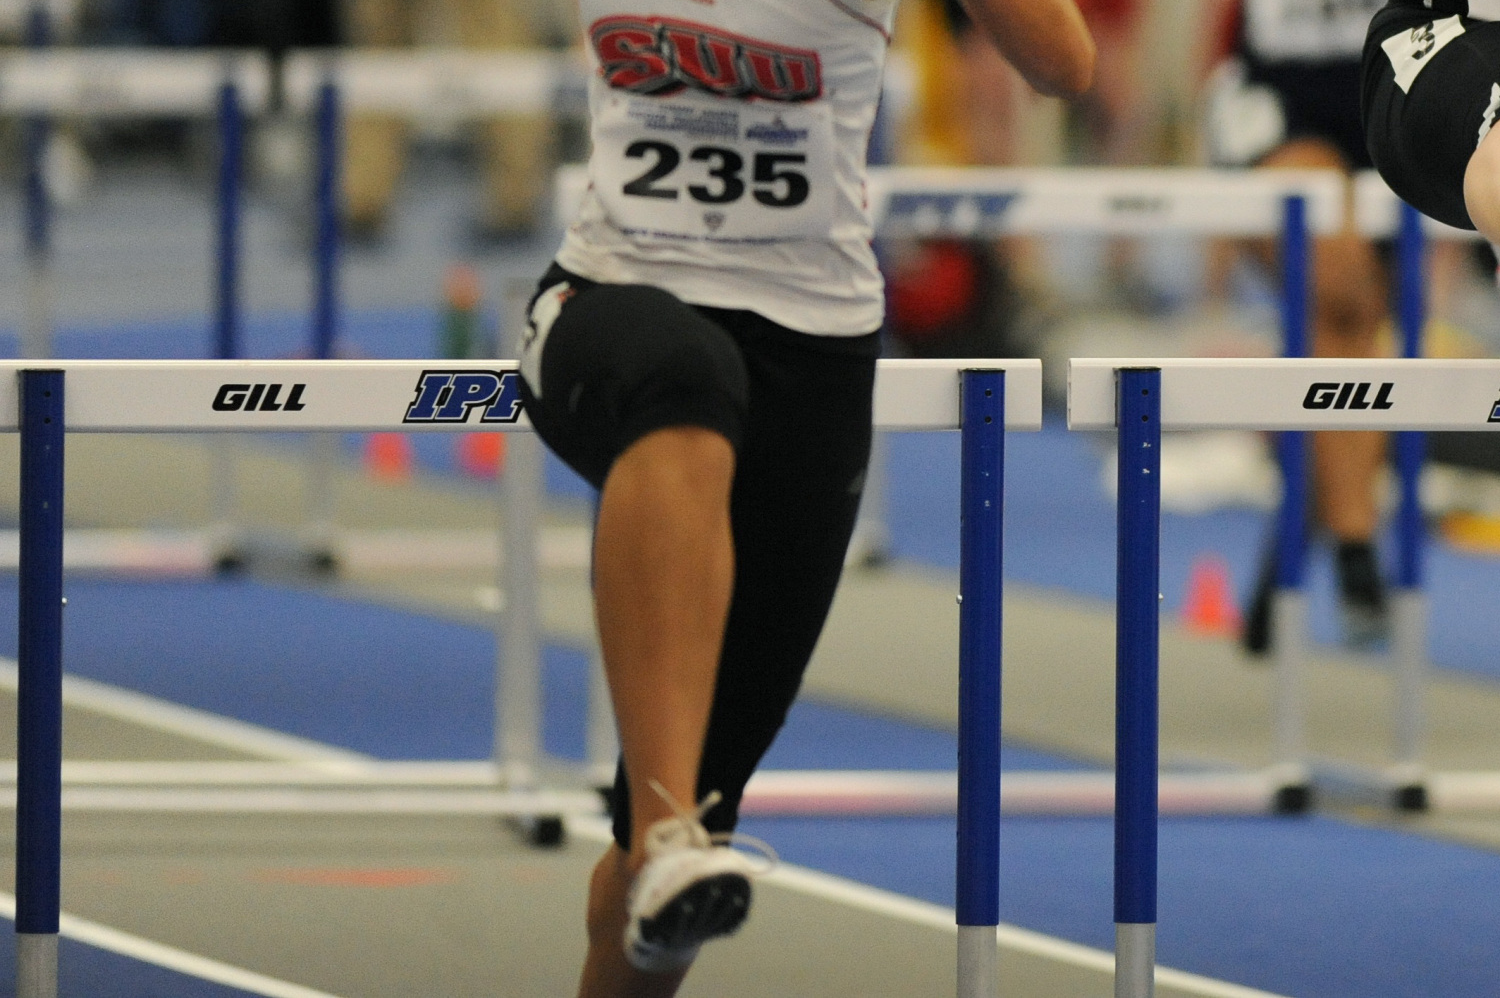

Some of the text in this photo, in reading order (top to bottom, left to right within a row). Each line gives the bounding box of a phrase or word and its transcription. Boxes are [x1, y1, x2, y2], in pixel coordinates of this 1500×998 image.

[623, 140, 810, 208] 235
[212, 370, 526, 423] GILL IPF
[1302, 383, 1394, 410] GILL
